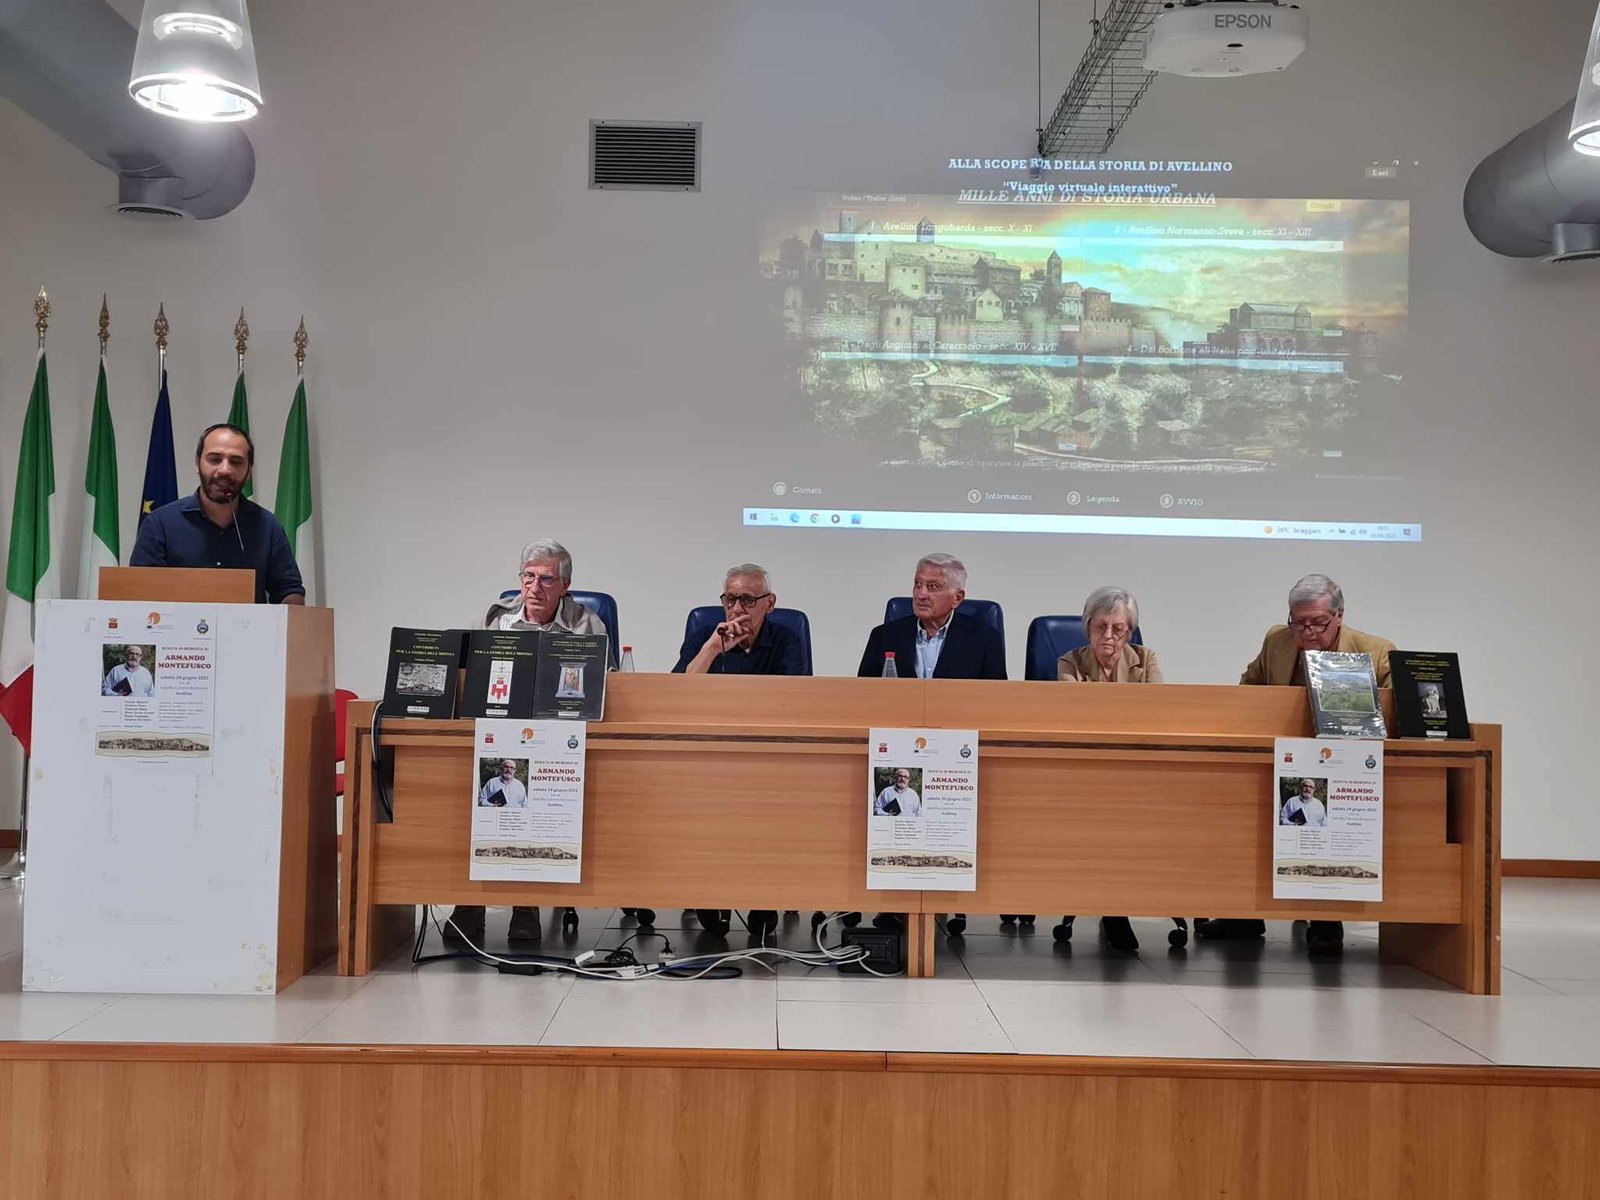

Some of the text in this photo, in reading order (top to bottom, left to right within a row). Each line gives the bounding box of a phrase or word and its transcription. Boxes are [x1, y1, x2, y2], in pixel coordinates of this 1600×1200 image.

[1214, 14, 1272, 28] EPSON
[948, 158, 982, 168] ALLA
[1054, 159, 1096, 170] DELLA
[1098, 160, 1146, 171] STORIA
[1148, 160, 1163, 171] DI
[1166, 160, 1233, 172] AVELLINO
[1003, 182, 1178, 194] "Viaggio virtuale interattivo"
[958, 189, 1217, 204] MILLE ANNI DI STORIA URBANA
[1008, 224, 1015, 232] X
[1276, 227, 1287, 236] XI
[1014, 342, 1030, 351] XIV
